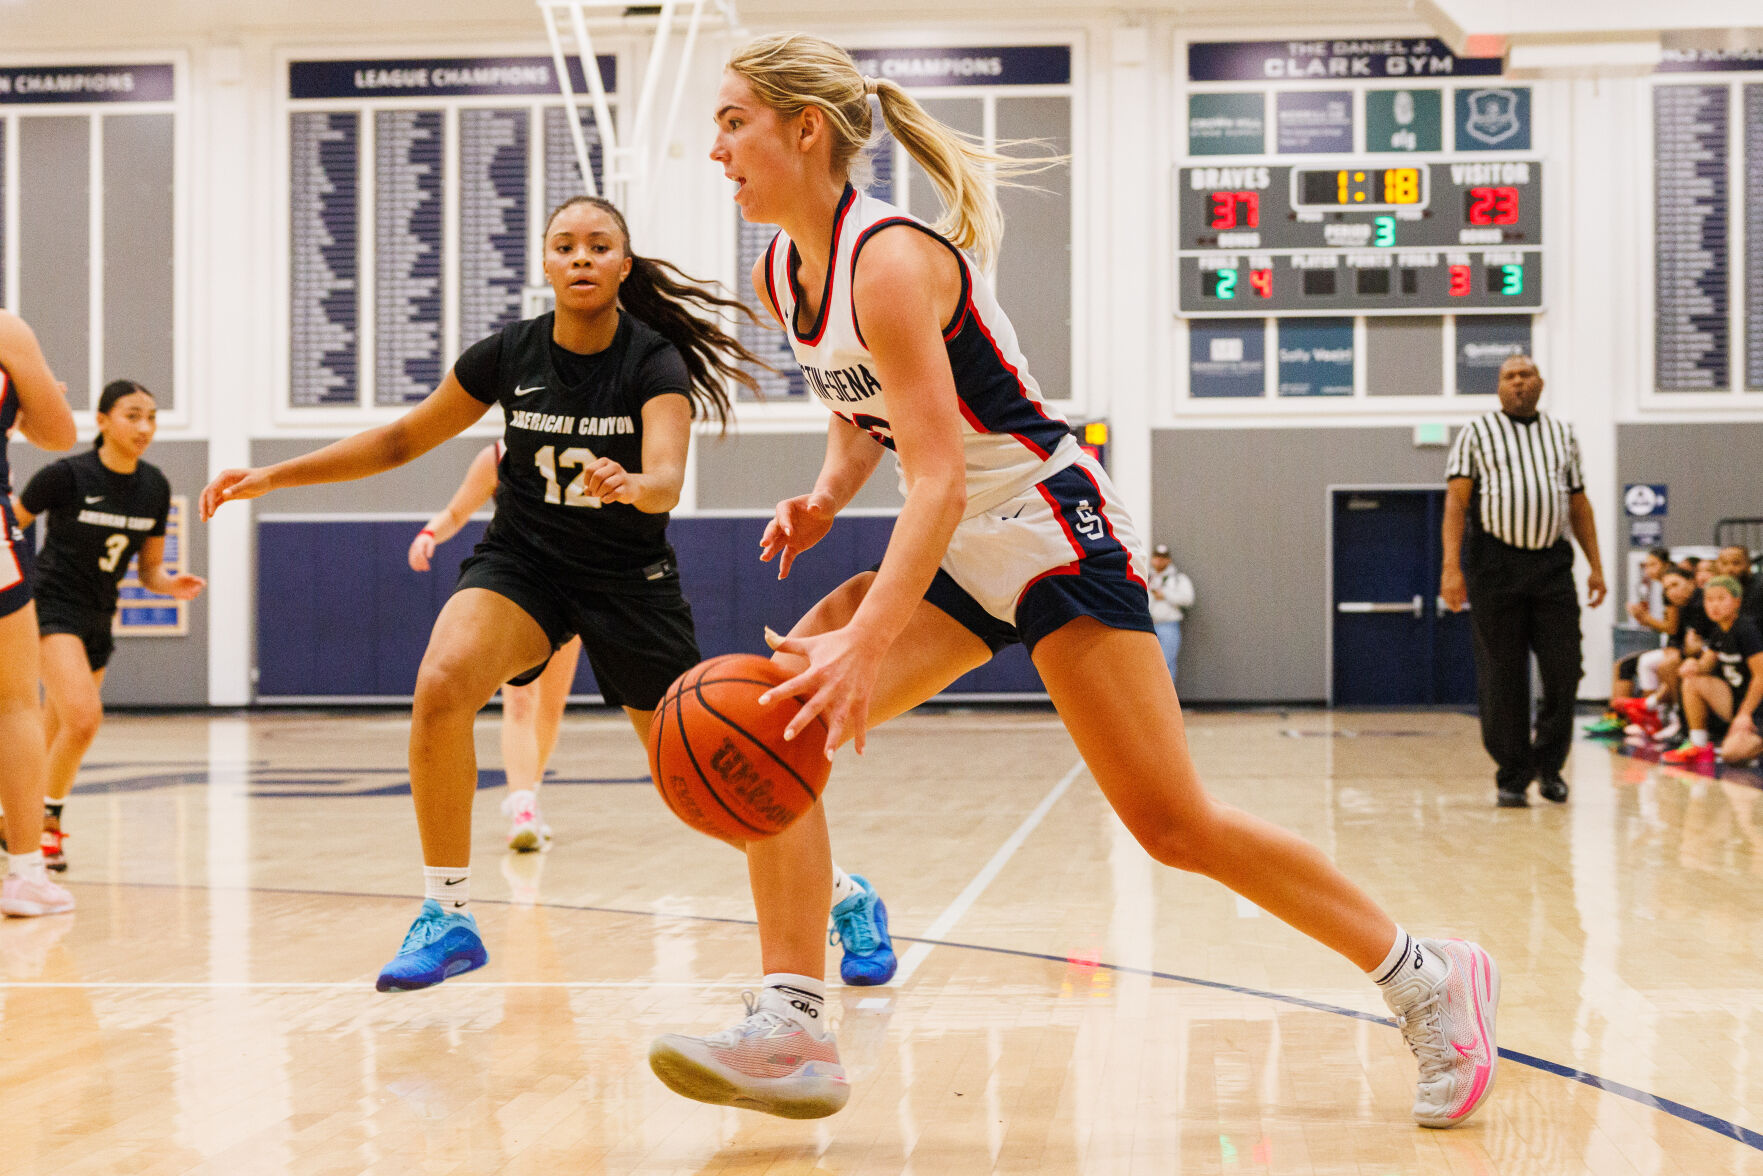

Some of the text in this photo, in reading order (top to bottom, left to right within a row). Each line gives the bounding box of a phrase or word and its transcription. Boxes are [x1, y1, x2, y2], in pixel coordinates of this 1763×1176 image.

[1288, 42, 1327, 56] THE
[1333, 41, 1405, 55] DANIEL
[354, 66, 549, 88] LEAGUE CHAMPIONS
[881, 57, 1003, 77] CHAMPIONS
[1263, 55, 1454, 77] CLARK GYM
[14, 72, 135, 94] CHAMPIONS
[1190, 167, 1271, 190] BRAVES
[1451, 163, 1530, 185] VISITOR
[1211, 191, 1260, 229] 37
[1469, 187, 1519, 226] 23
[1374, 216, 1396, 247] 3
[1216, 268, 1238, 300] 2
[1249, 268, 1272, 299] 4
[1448, 264, 1471, 296] 3
[1501, 264, 1523, 295] 3
[578, 416, 635, 436] CANYON
[534, 445, 603, 509] 12
[98, 533, 130, 573] 3
[790, 999, 819, 1019] alo
